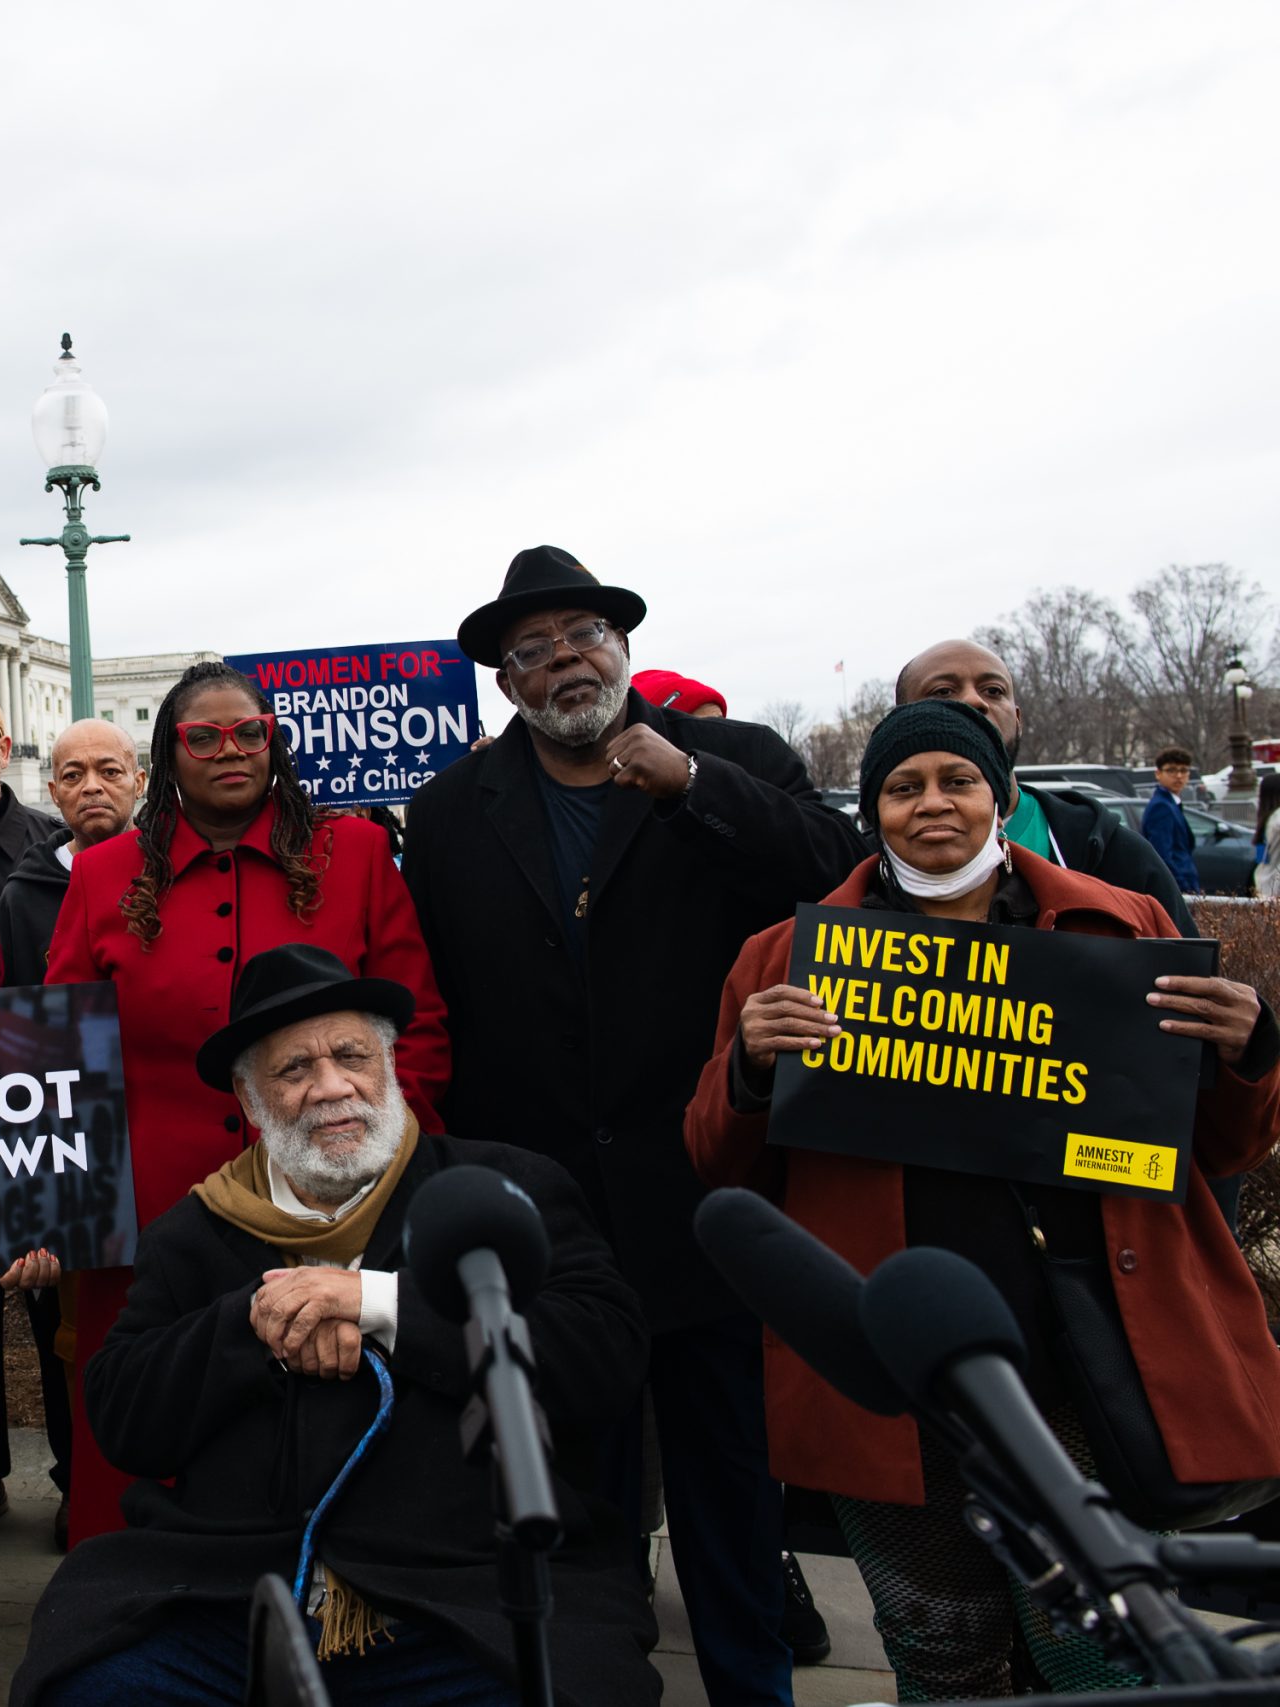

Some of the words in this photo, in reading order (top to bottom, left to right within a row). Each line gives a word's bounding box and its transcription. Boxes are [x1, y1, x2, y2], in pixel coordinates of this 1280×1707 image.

[256, 655, 370, 689] WOMEN
[380, 650, 442, 680] FOR
[274, 683, 409, 717] BRANDON
[276, 704, 469, 755] OHNSON
[330, 771, 357, 794] of
[363, 767, 436, 791] Chica
[814, 923, 955, 977] INVEST
[967, 941, 1009, 985] IN
[808, 974, 1054, 1045] WELCOMING
[1075, 1159, 1132, 1175] INTERNATIONAL
[1077, 1144, 1134, 1164] AMNESTY
